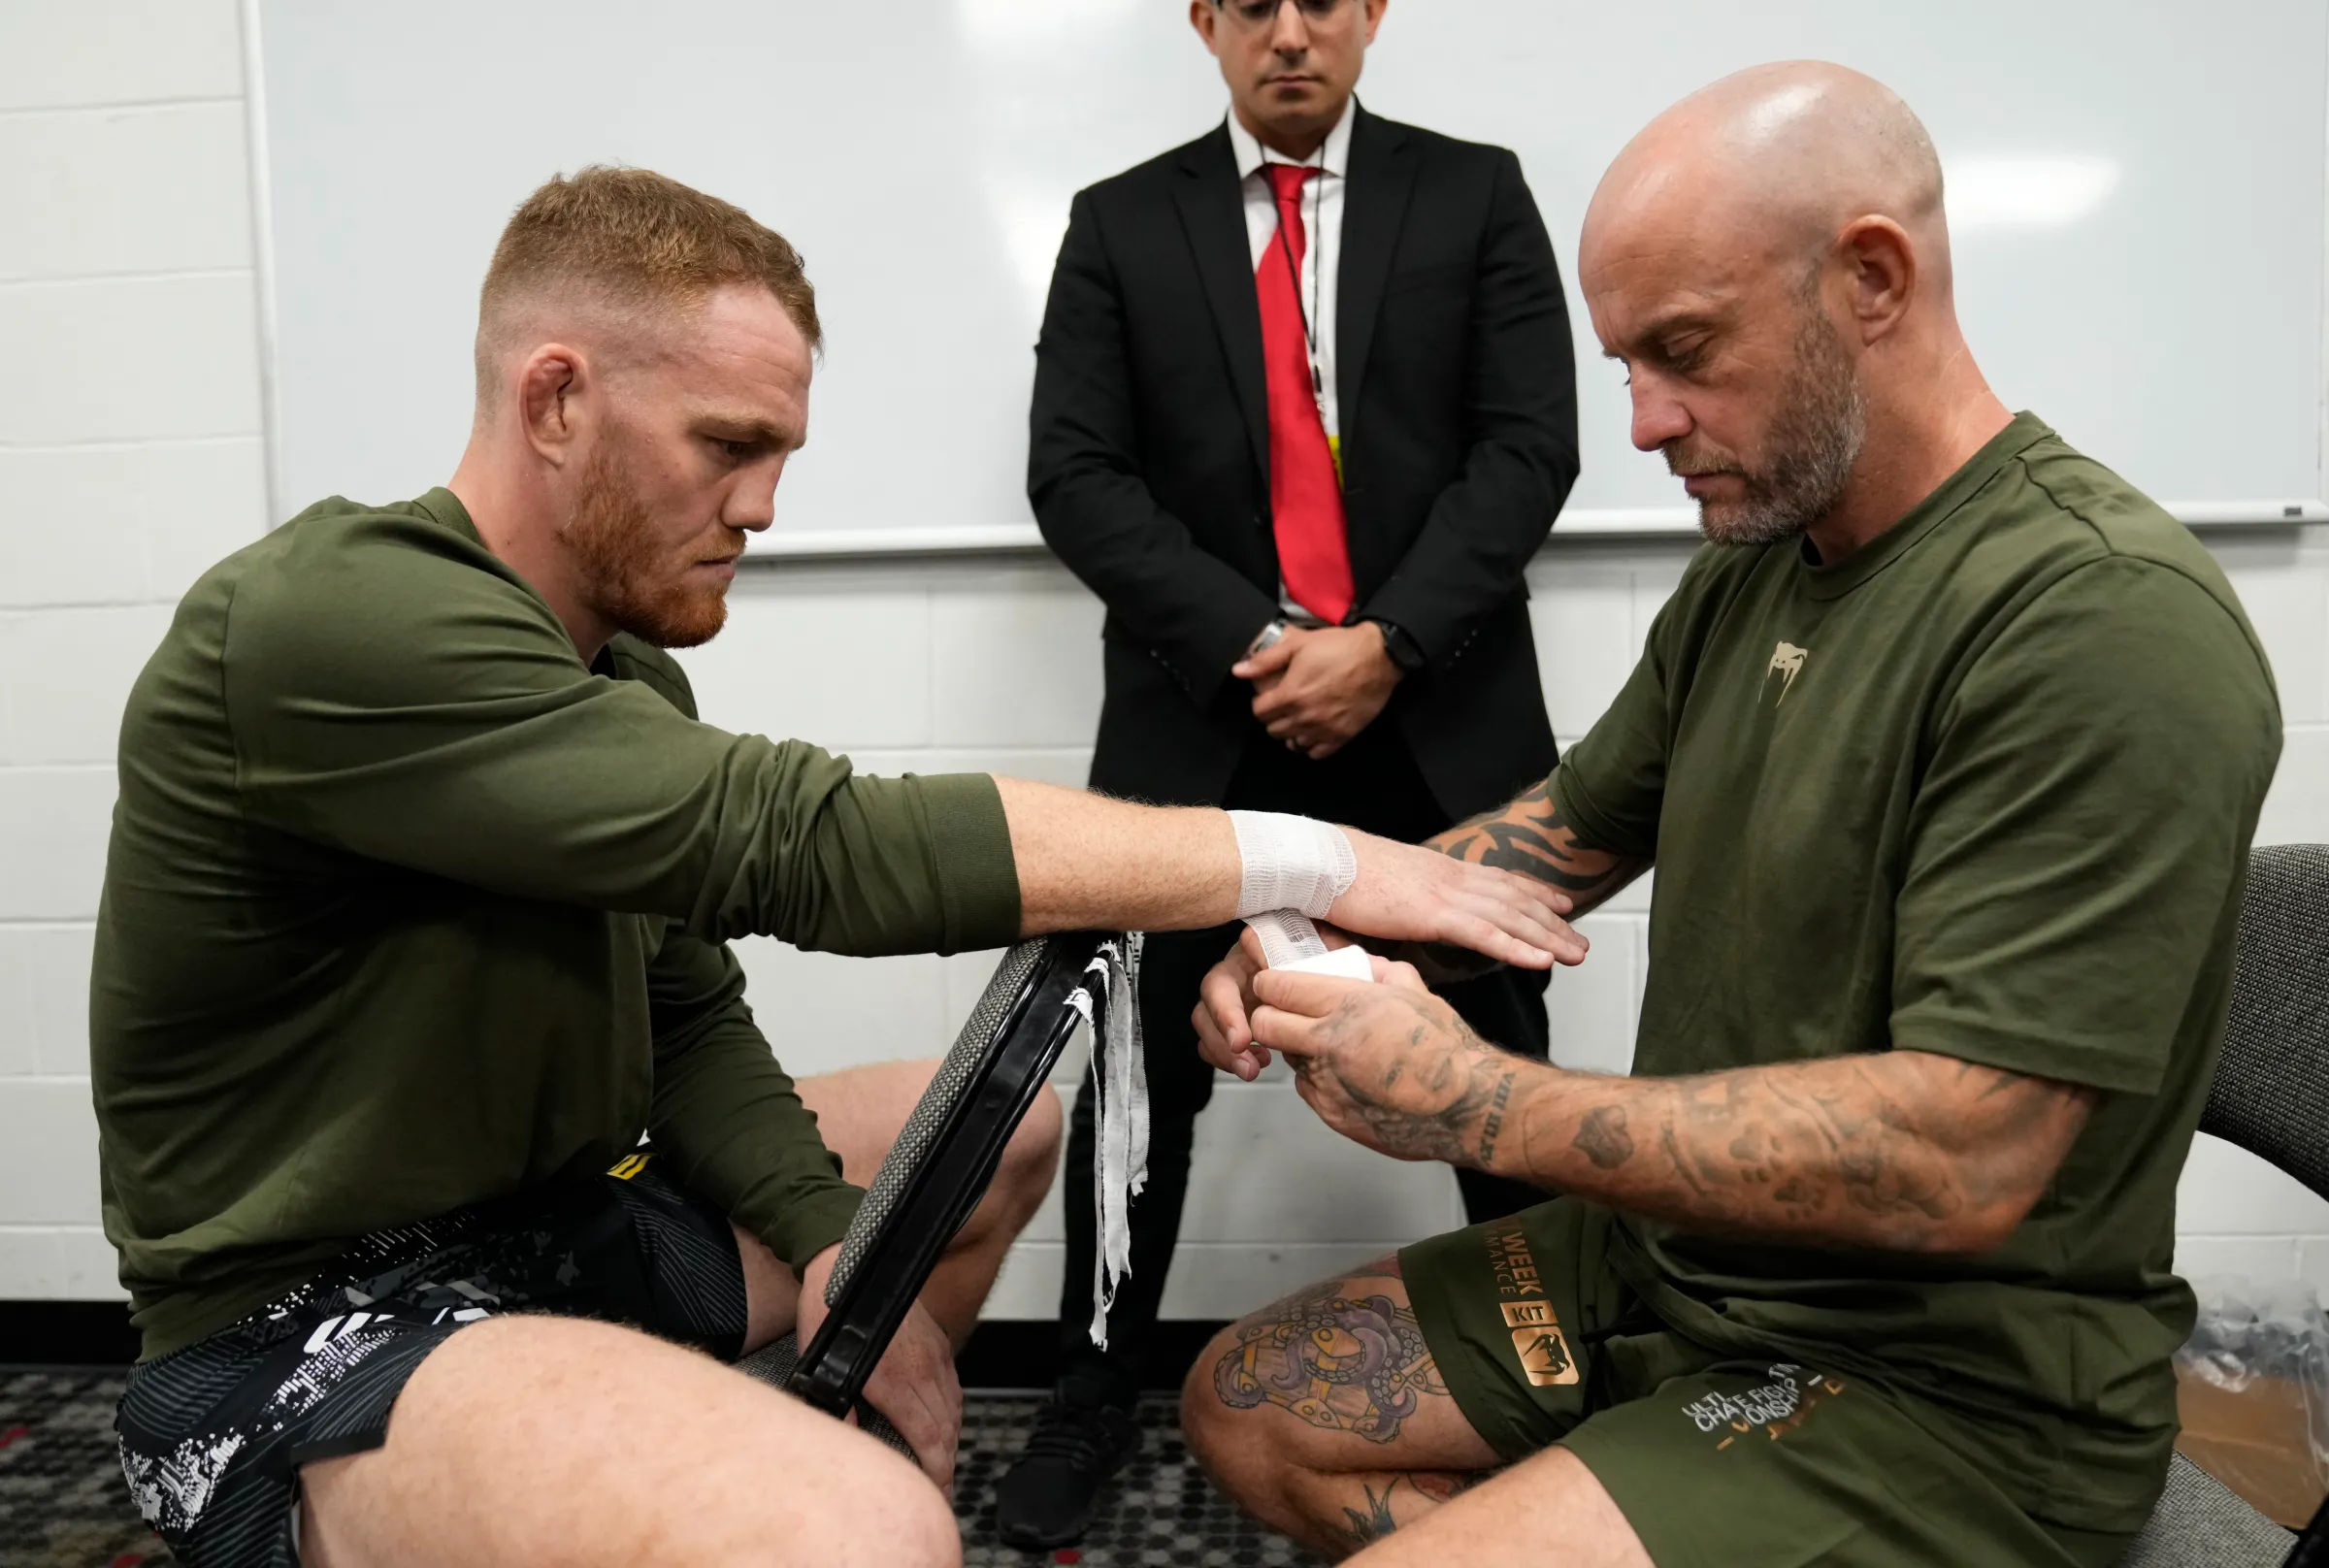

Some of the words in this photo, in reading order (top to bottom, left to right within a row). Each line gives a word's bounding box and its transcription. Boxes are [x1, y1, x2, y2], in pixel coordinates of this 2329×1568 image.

[1502, 1231, 1543, 1295] WEEK
[1511, 1305, 1544, 1323] KIT
[1694, 1377, 1801, 1432] CHAIONSHIP
